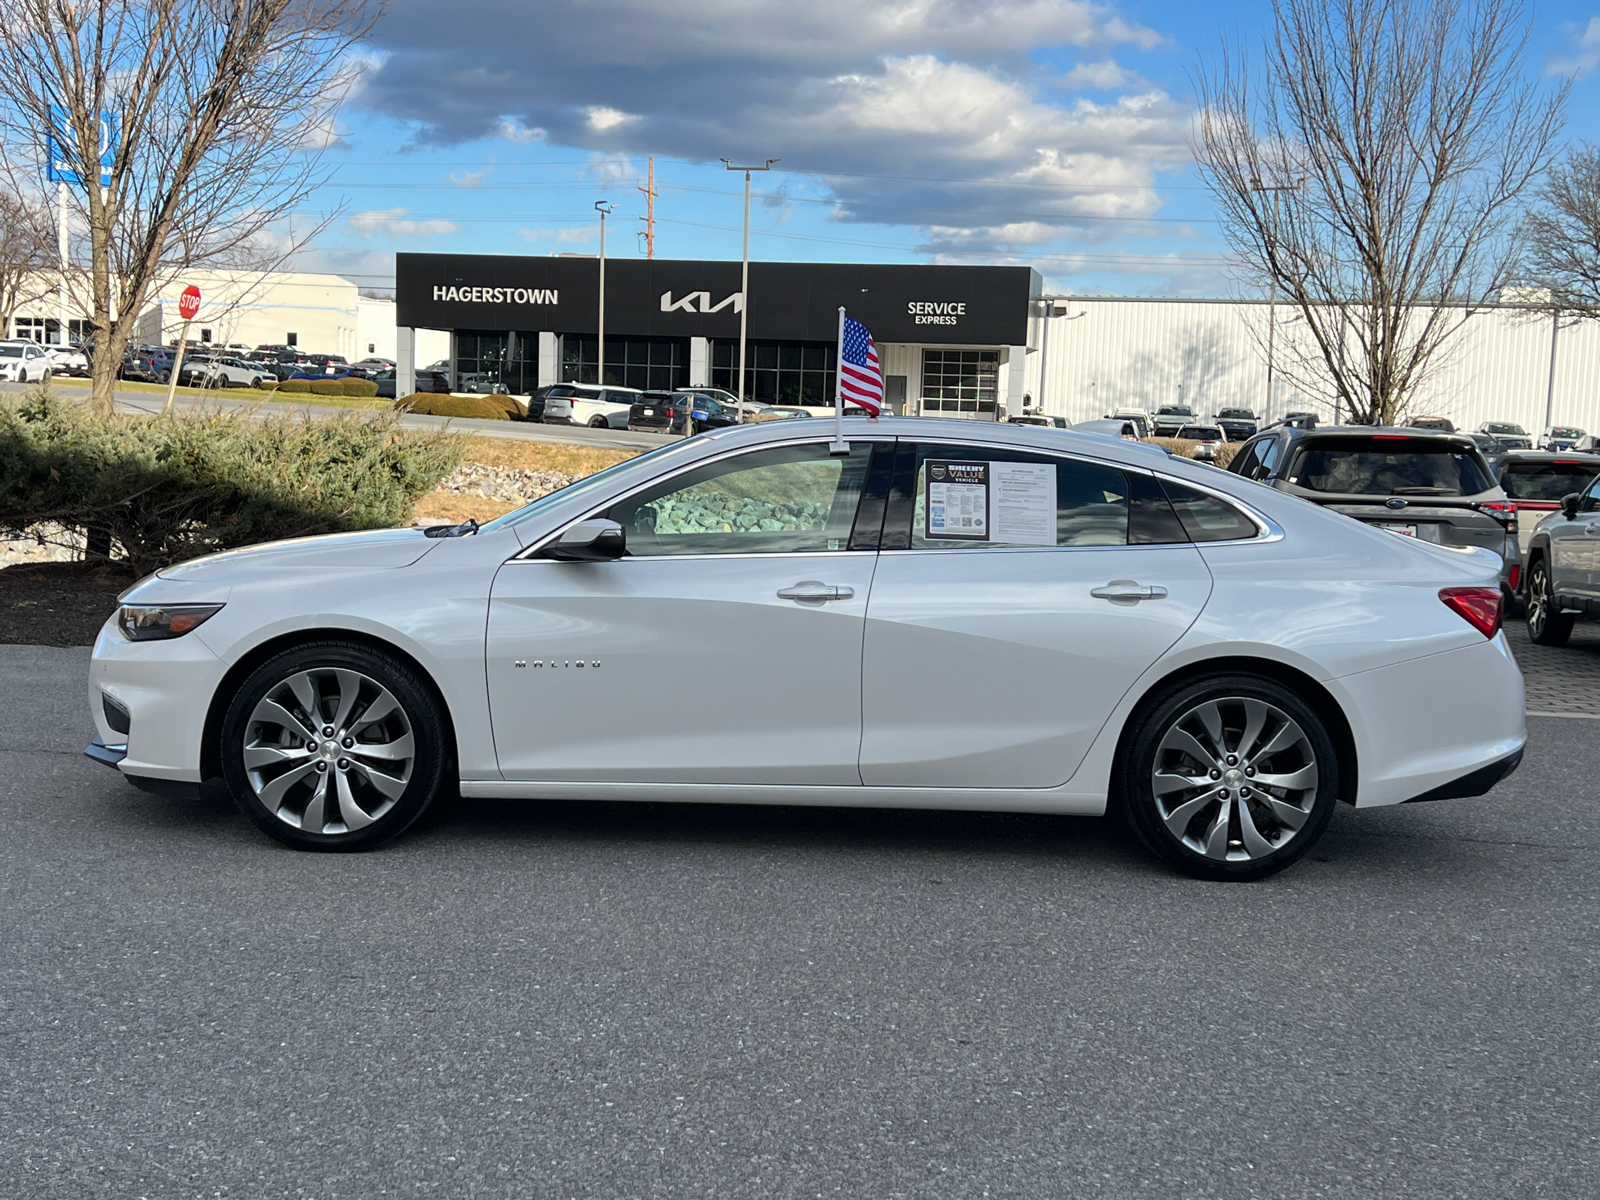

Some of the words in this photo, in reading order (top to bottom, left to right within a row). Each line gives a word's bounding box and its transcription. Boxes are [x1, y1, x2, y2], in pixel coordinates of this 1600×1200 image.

[180, 293, 200, 311] STOP
[433, 285, 558, 305] HAGERSTOWN
[661, 290, 743, 314] KIA
[907, 301, 967, 315] SERVICE
[915, 315, 957, 325] EXPRESS
[514, 659, 602, 668] MALIBU
